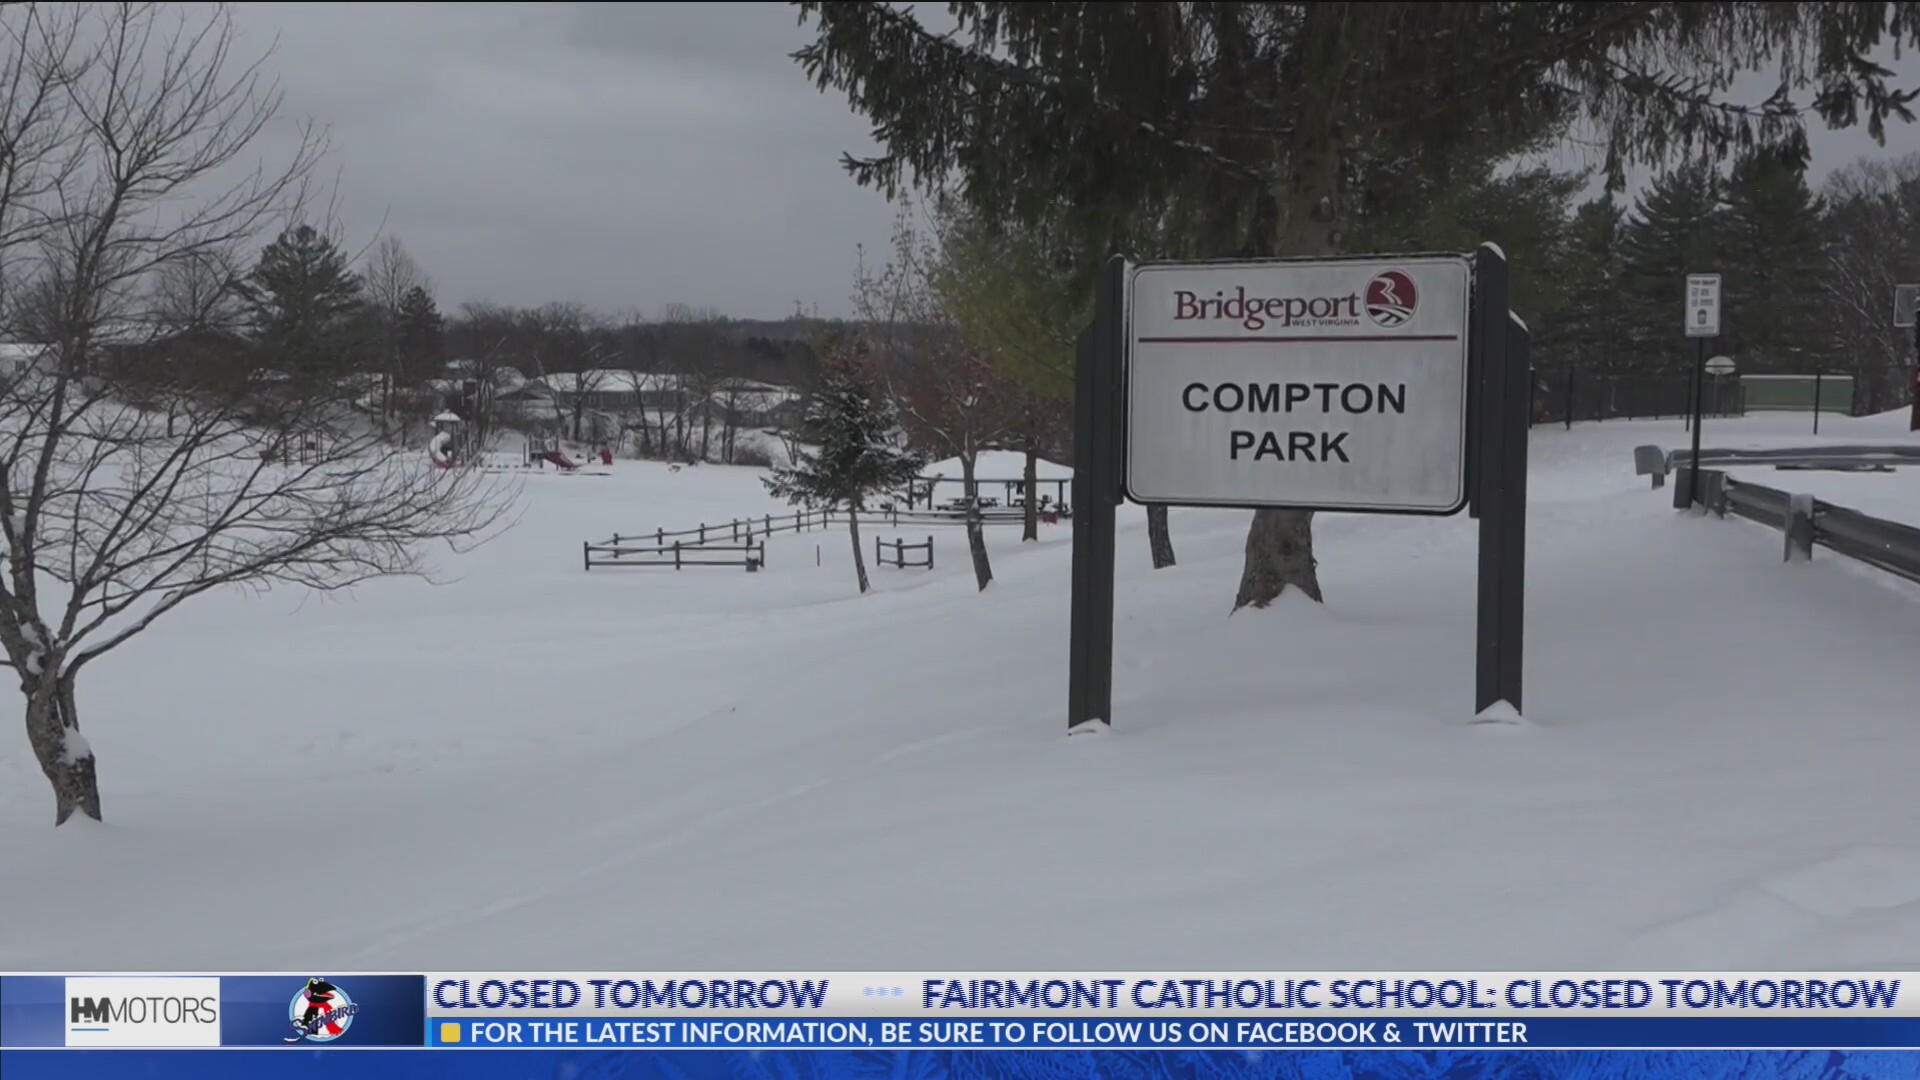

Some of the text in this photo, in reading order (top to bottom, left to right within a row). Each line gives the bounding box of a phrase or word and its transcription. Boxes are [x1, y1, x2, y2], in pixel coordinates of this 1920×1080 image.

[1173, 286, 1360, 331] Bridgeport
[1291, 318, 1360, 327] WEST VIRGINIA
[1182, 382, 1406, 414] COMPTON
[1230, 431, 1350, 463] PARK
